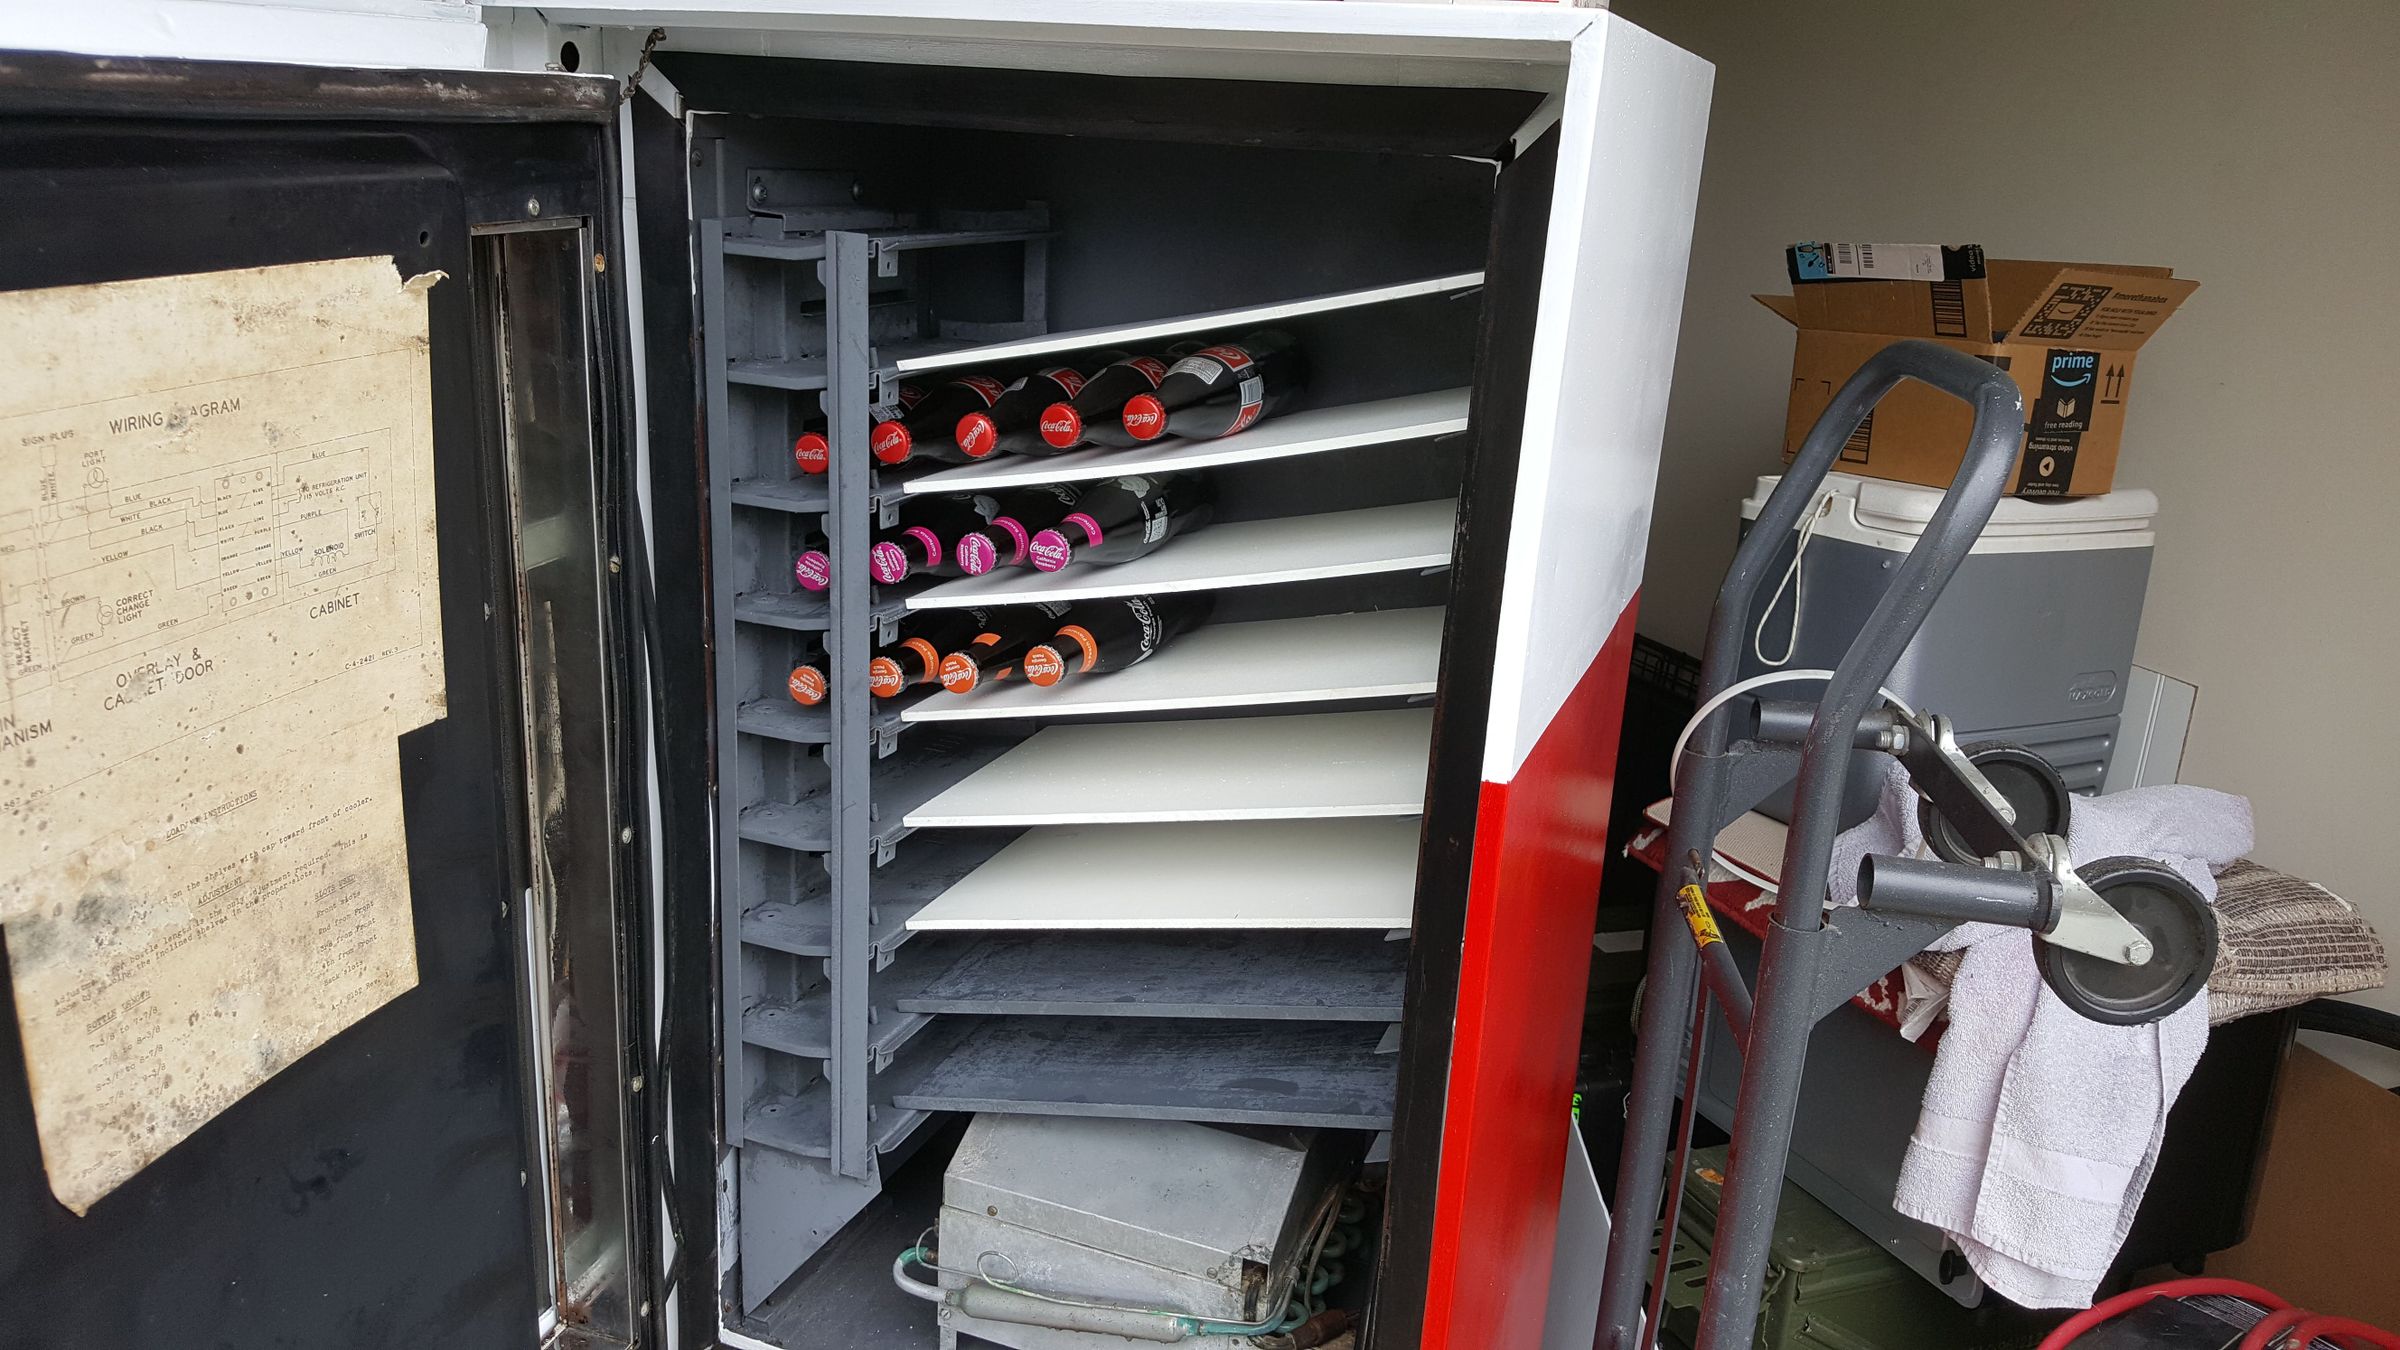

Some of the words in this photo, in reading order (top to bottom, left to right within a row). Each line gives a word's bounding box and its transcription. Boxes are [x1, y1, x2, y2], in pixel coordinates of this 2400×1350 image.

[2052, 352, 2094, 373] prime
[109, 411, 164, 435] WIRING
[2044, 420, 2058, 430] free
[2058, 420, 2083, 430] reading
[83, 449, 104, 459] PORT
[312, 450, 326, 459] BLUE
[355, 471, 368, 480] UNIT
[124, 493, 142, 503] BLUE
[217, 494, 232, 502] BLACK
[315, 487, 333, 498] VOLTS
[149, 496, 172, 508] BLACK
[120, 512, 141, 523] WHITE
[300, 509, 322, 520] PURPLE
[141, 524, 163, 538] BLACK
[354, 528, 376, 540] SWITCH
[281, 547, 304, 558] YELLOW
[314, 542, 345, 557] SOLENOID
[101, 550, 129, 563] YELLOW
[318, 567, 337, 578] GREEN
[116, 589, 155, 607] CORRECT
[116, 599, 150, 616] CHANGE
[309, 592, 360, 620] CABINET
[117, 610, 143, 625] LIGHT
[157, 618, 179, 630] GREEN
[70, 631, 95, 645] GREEN
[192, 647, 202, 661] &
[175, 659, 214, 685] DOOR
